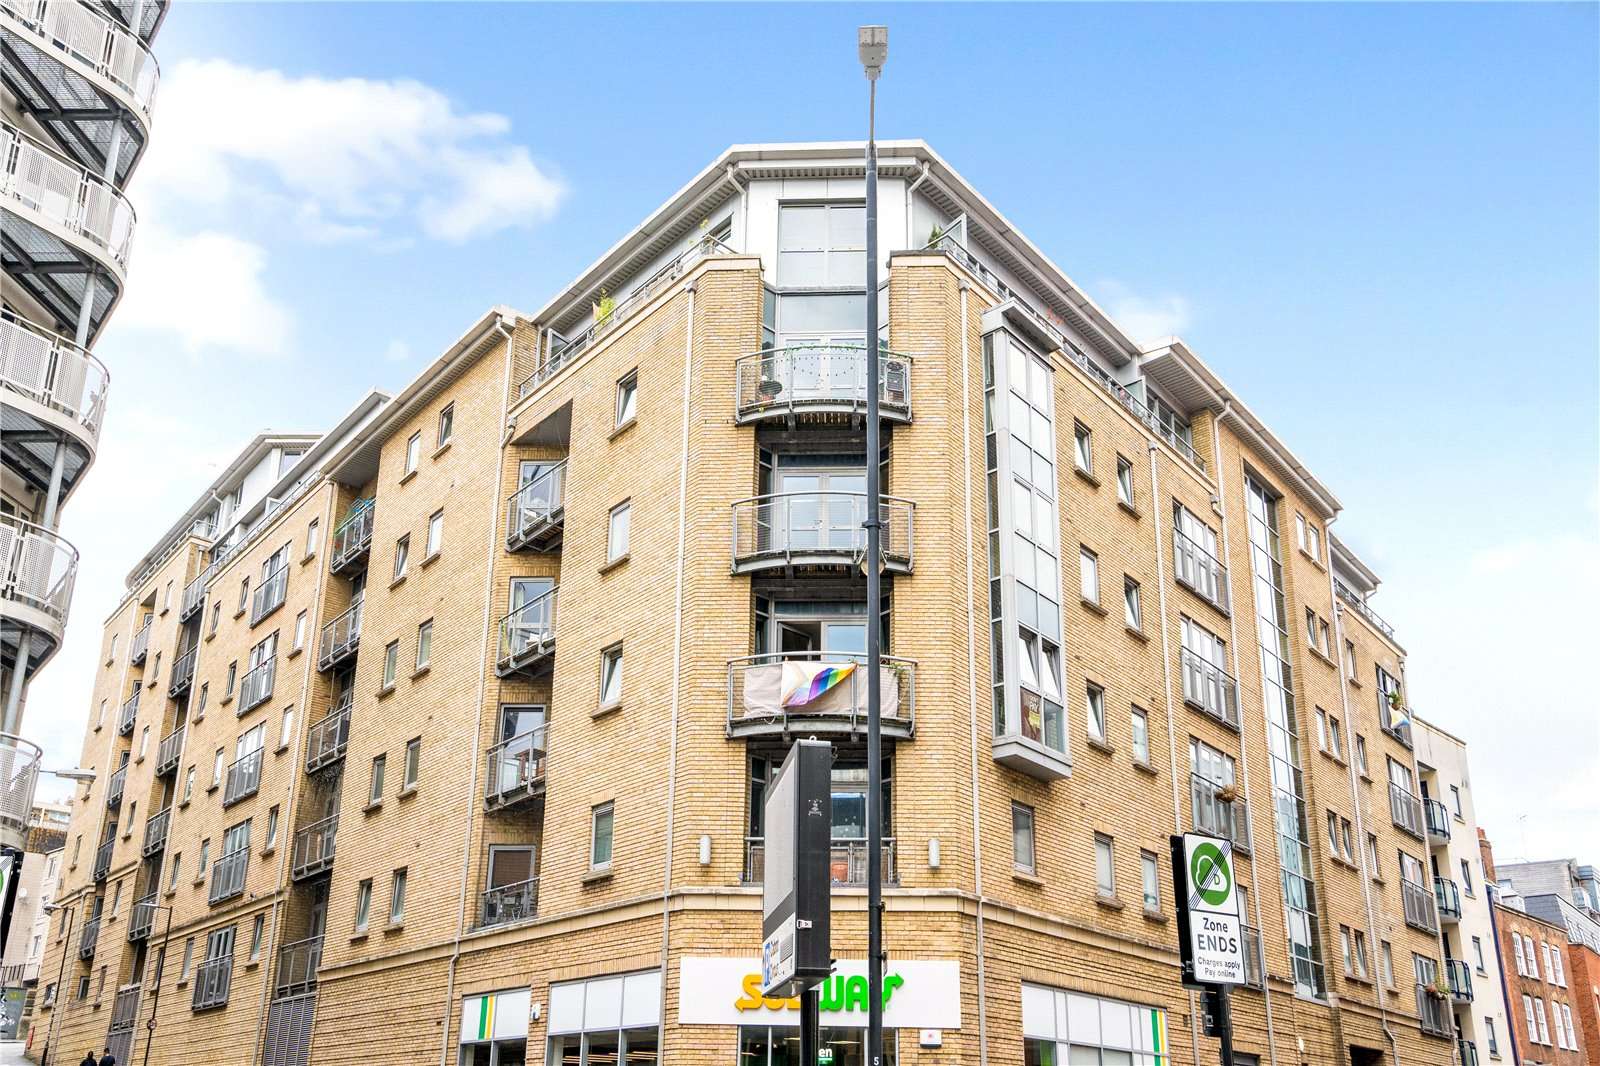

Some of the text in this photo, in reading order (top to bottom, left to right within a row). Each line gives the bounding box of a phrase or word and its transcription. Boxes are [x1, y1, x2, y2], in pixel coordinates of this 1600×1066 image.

[1202, 917, 1228, 933] Zone
[1197, 934, 1237, 954] ENDS
[1197, 956, 1241, 970] Charges apply
[1204, 967, 1236, 978] Pay online
[873, 1056, 880, 1066] 5
